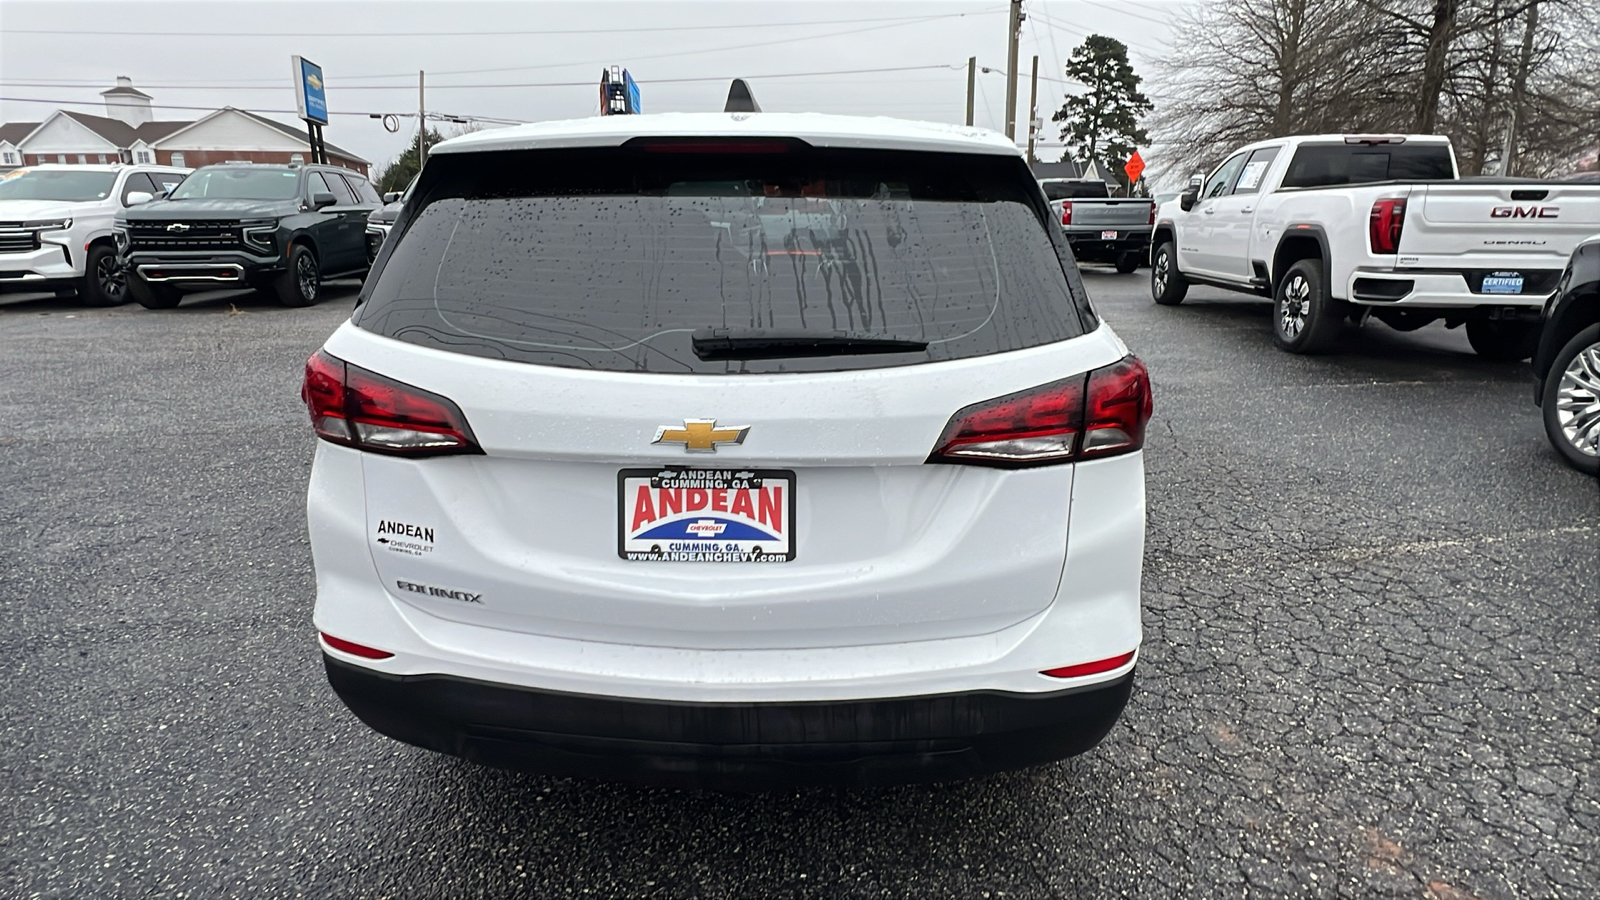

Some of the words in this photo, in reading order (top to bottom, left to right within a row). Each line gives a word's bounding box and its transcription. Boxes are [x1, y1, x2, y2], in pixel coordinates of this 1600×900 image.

[1490, 206, 1560, 219] GMC
[1483, 277, 1525, 286] CERTIFIED
[679, 470, 732, 480] ANDEAN
[661, 479, 728, 490] CUMMING,
[733, 479, 750, 489] GA
[631, 485, 783, 534] ANDEAN
[377, 519, 435, 543] ANDEAN
[390, 540, 434, 552] CHEVROLET
[669, 542, 724, 553] CUMMING,
[725, 543, 744, 552] GA.
[627, 552, 787, 562] www.ANDEANCHEVY.com
[396, 580, 484, 605] EQUINOX
